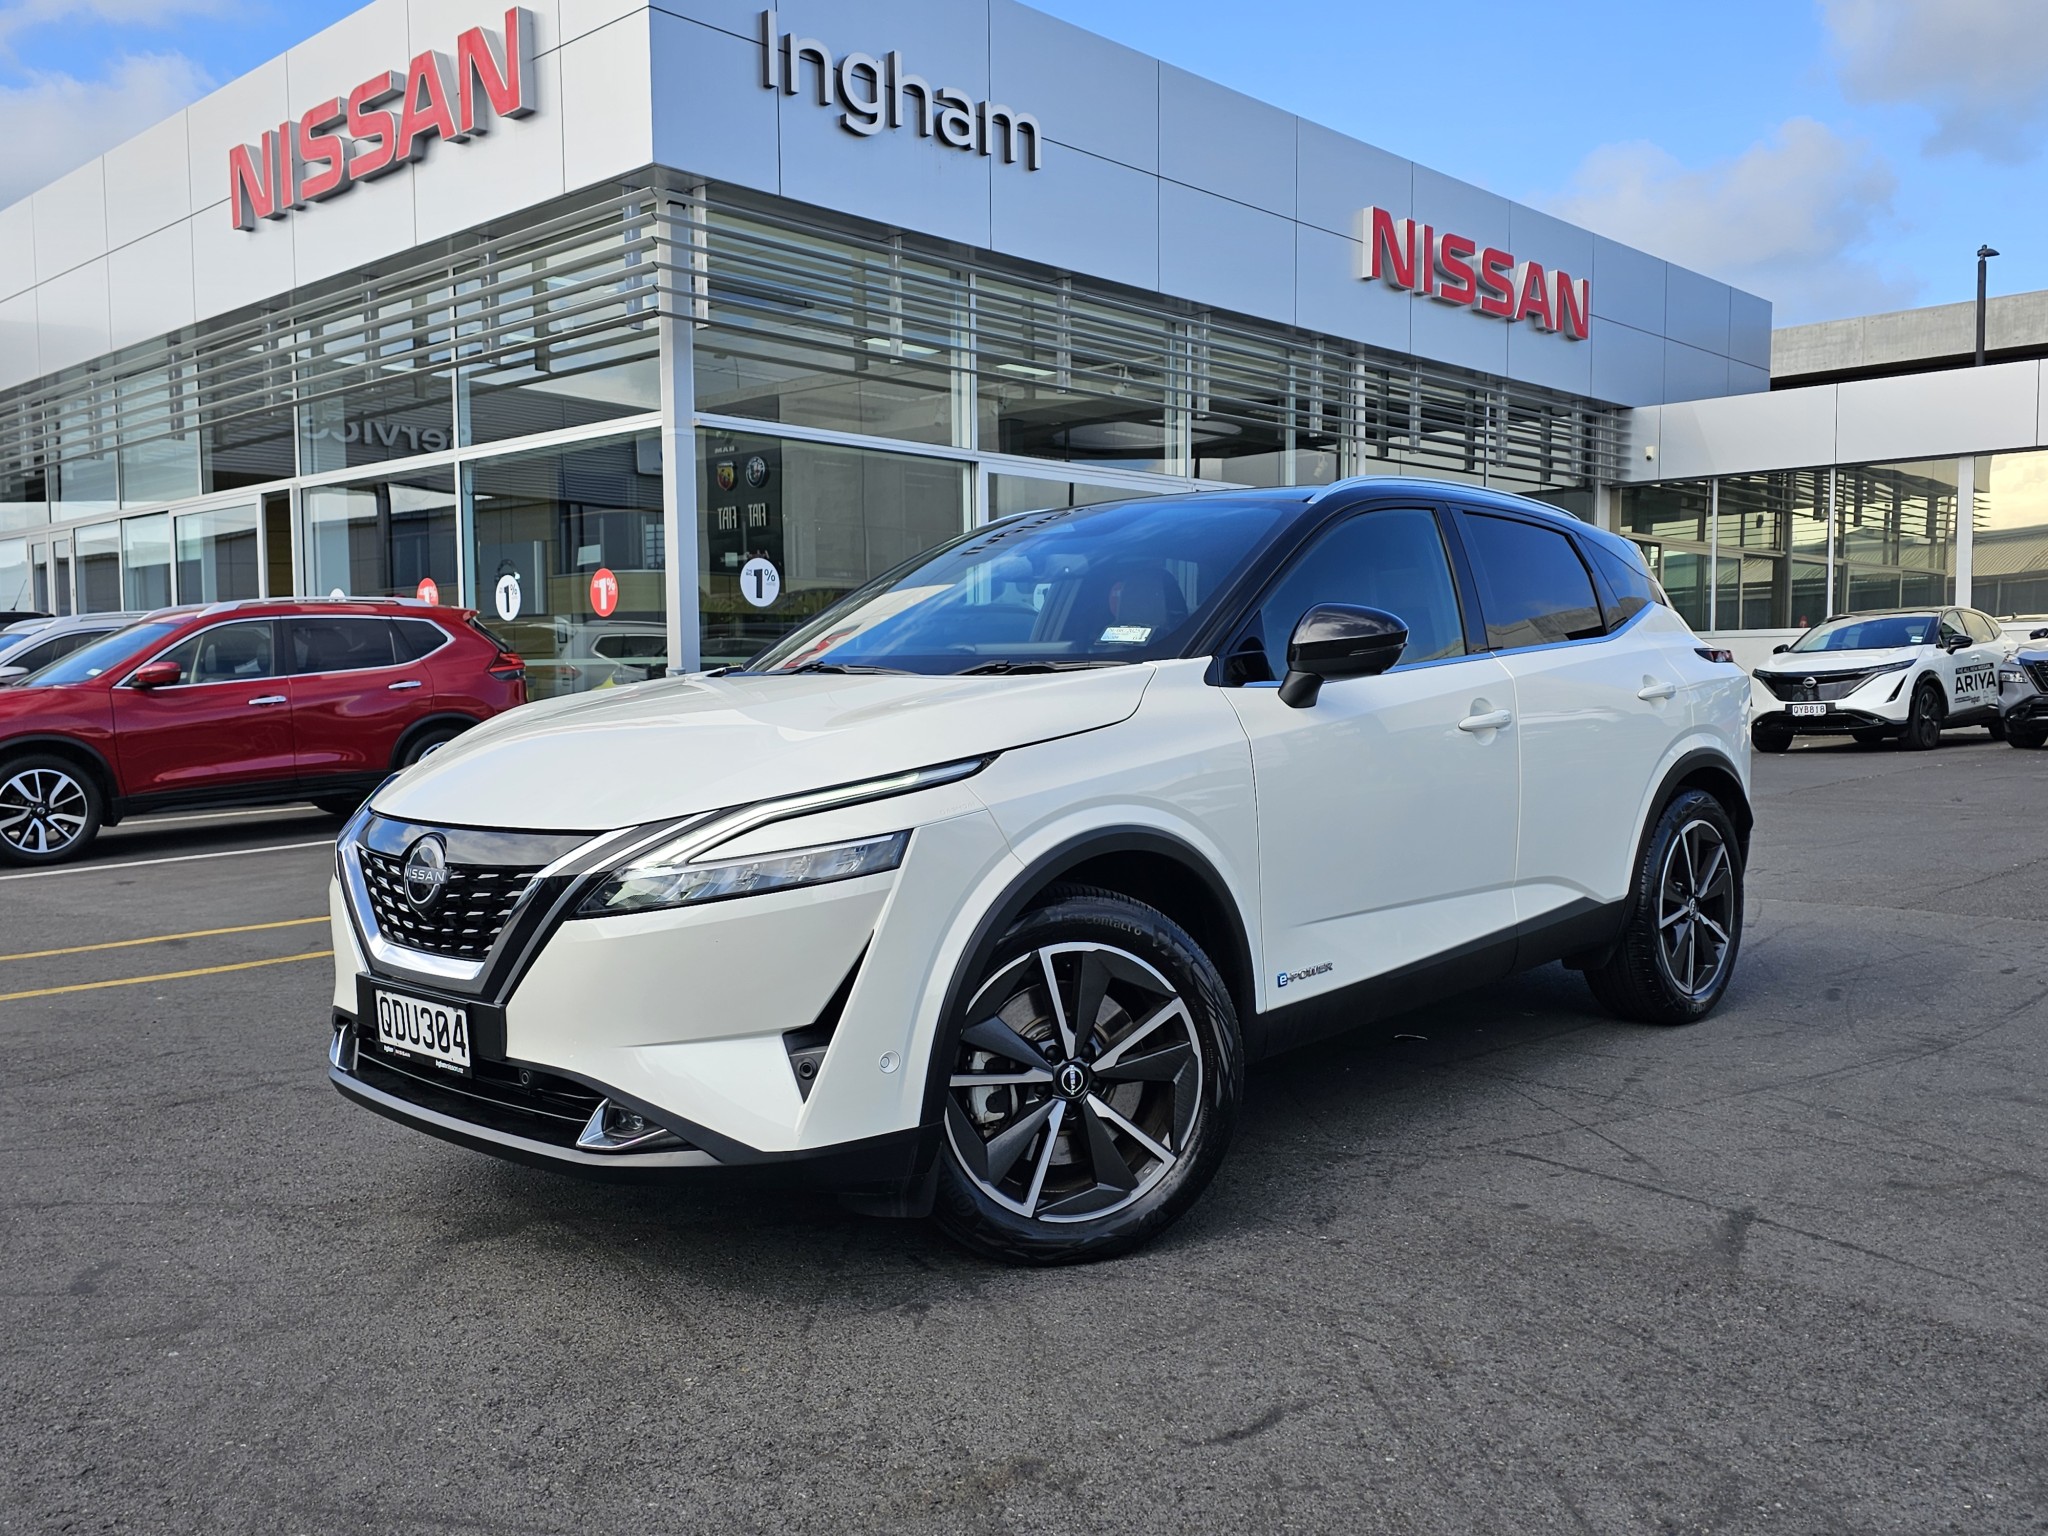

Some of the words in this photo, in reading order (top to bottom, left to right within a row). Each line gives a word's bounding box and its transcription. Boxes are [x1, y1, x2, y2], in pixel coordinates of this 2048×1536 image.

[761, 9, 1042, 171] Ingham
[229, 6, 533, 231] NISSAN
[1362, 206, 1589, 341] NISSAN
[503, 584, 518, 613] 1%
[598, 577, 616, 610] 1%
[754, 568, 776, 599] 1%
[1955, 671, 1997, 694] ARIYA
[1793, 705, 1825, 714] QYB818
[406, 866, 445, 882] NISSAN
[380, 996, 466, 1058] QDU304
